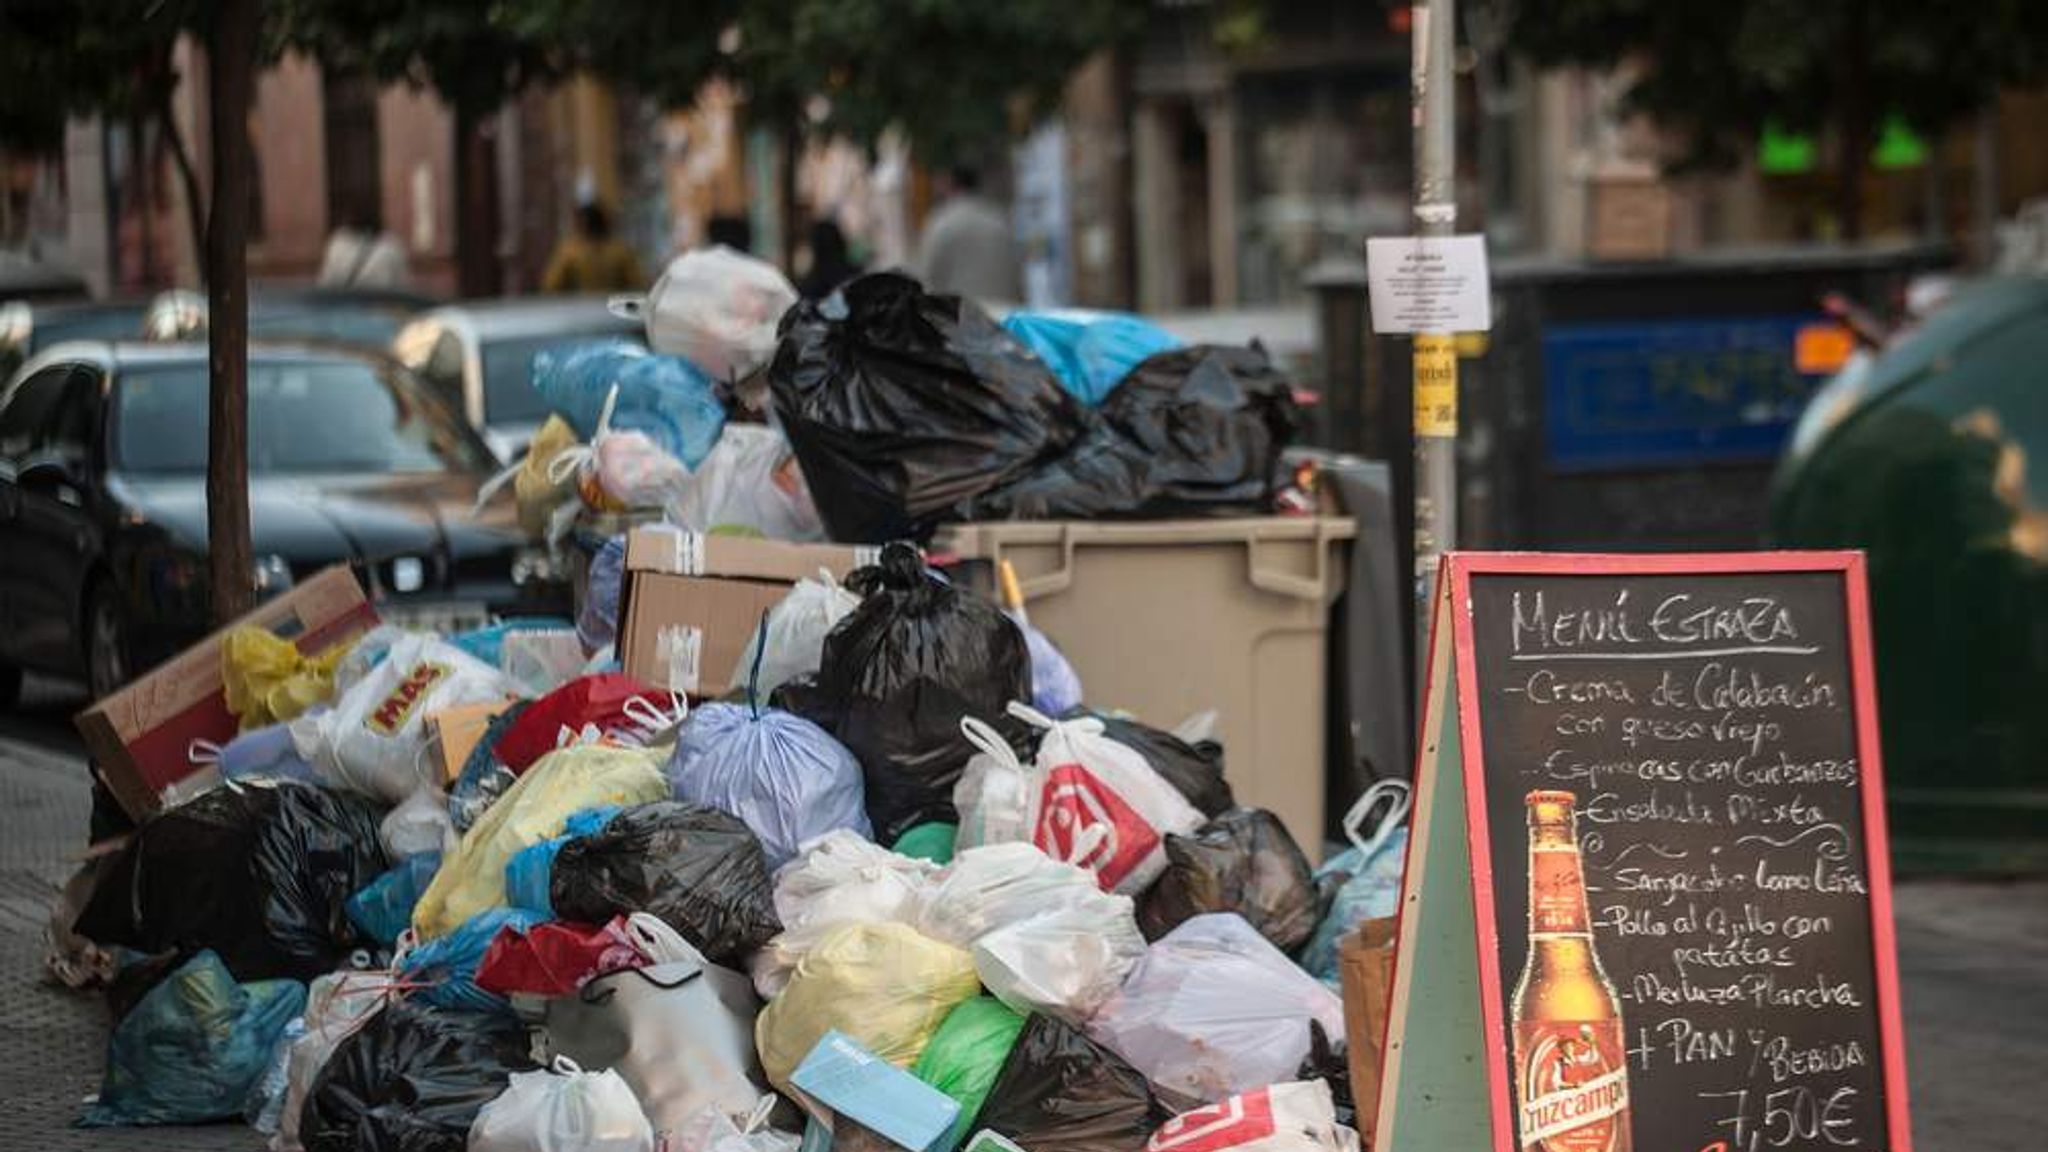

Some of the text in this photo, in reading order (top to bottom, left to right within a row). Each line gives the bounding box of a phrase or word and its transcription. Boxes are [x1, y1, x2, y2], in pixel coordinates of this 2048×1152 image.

[1653, 671, 1688, 705] de
[1556, 715, 1604, 735] con
[1621, 717, 1702, 747] queso
[1673, 903, 1697, 934] al
[1782, 915, 1833, 938] con
[1739, 973, 1863, 1008] Plancha
[1657, 1019, 1735, 1064] PAN
